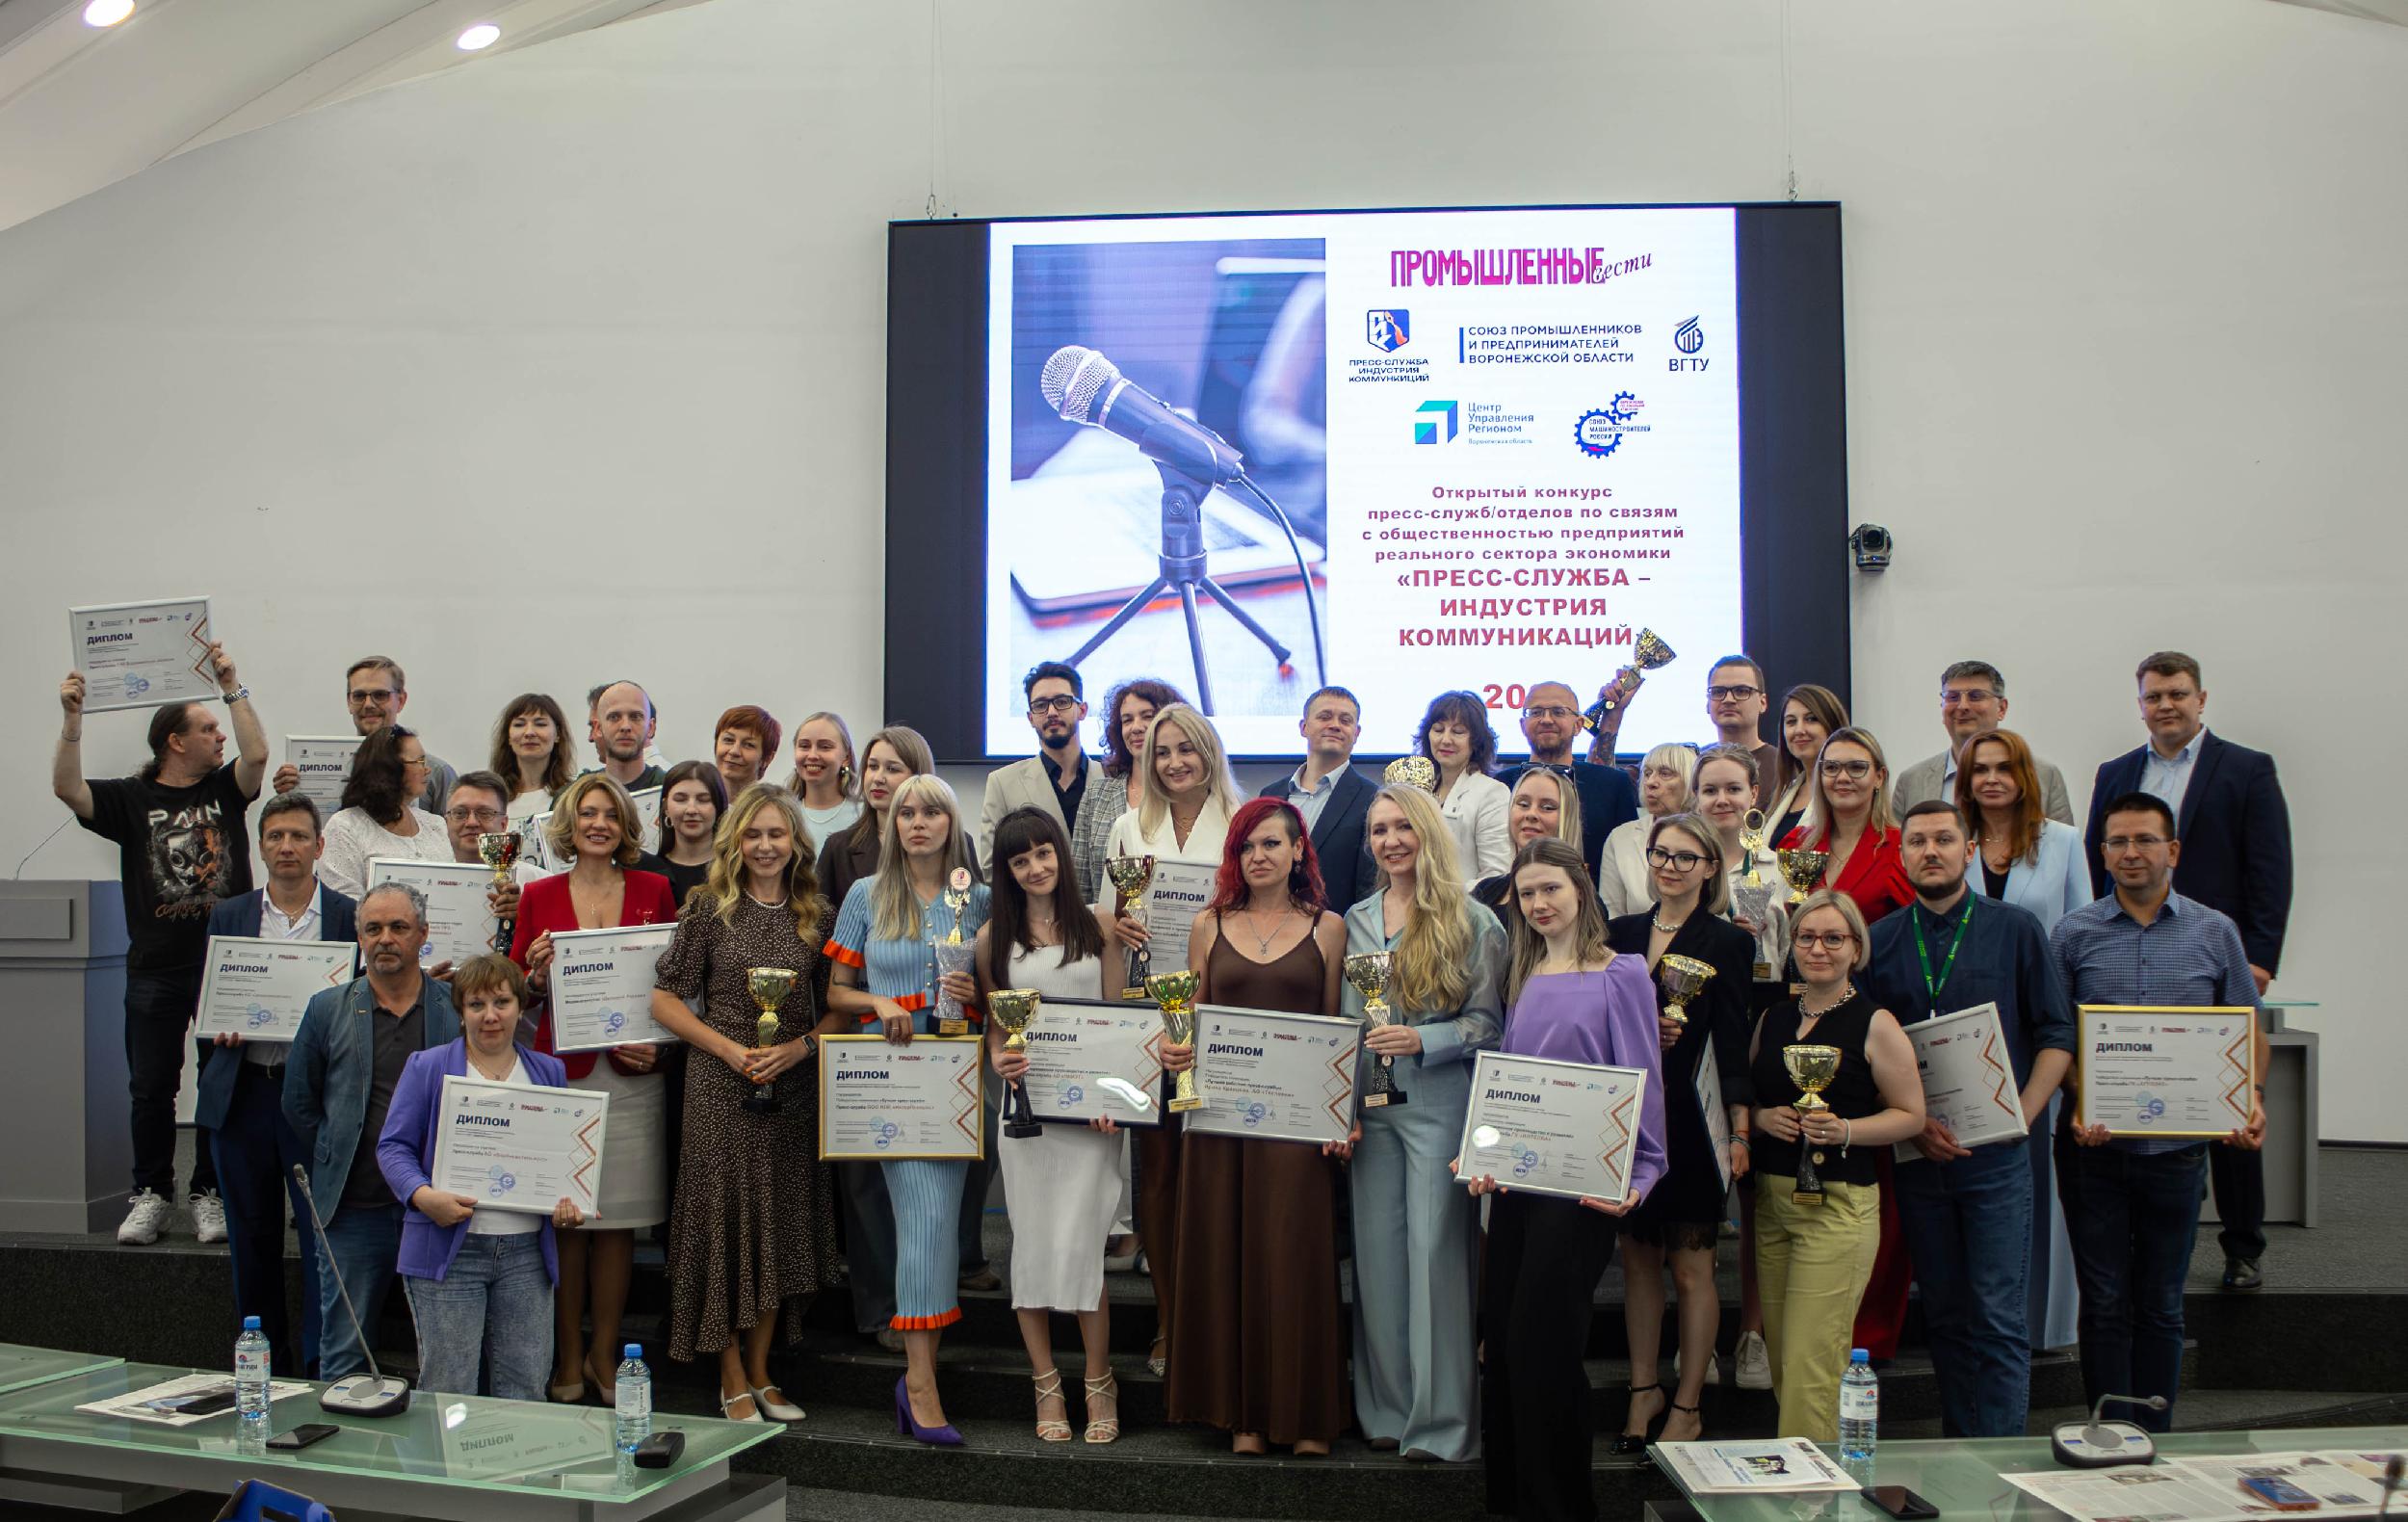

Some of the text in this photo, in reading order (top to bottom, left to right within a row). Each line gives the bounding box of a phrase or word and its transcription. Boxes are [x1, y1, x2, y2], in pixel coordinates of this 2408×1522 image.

[1391, 248, 1606, 287] ПРОМЫШЛЕННЫЕ
[1468, 324, 1642, 336] СОЮЗ ПРОМЫШЛЕННИКОВ
[1468, 337, 1619, 351] И ПРЕДПРИНИМАТЕЛЕЙ
[1469, 352, 1634, 364] ВОРОНЕЖСКОЙ ОБЛАСТИ
[1668, 357, 1710, 372] ВГТУ
[1468, 403, 1502, 413] Центр
[1468, 412, 1534, 424] Управления
[1468, 423, 1522, 433] Регионом
[1431, 485, 1612, 501] Открытый конкурс
[1368, 506, 1678, 523] пресс-служб/отделов по связям
[1362, 525, 1684, 542] с общественностью предприятий
[1374, 549, 1670, 564] реального сектора экономики
[1397, 567, 1630, 588] «ПРЕСС-СЛУЖБА
[1440, 598, 1607, 619] ИНДУСТРИЯ
[87, 632, 133, 645] ДИПЛОМ
[1399, 623, 1632, 649] КОММУНИКАЦИЙ
[1482, 683, 1526, 710] 20
[299, 764, 343, 774] ДИПЛОМ
[148, 799, 222, 829] PAIN
[1153, 889, 1206, 903] ДИПЛОМ
[220, 963, 269, 974] ДИПЛОМ
[563, 961, 615, 977] ДИПЛОМ
[1026, 1031, 1078, 1043] ДИПЛОМ
[1207, 1043, 1264, 1058] ДИПЛОМ
[2095, 1042, 2153, 1053] ДИПЛОМ
[837, 1070, 890, 1081] ДИПЛОМ
[1485, 1089, 1541, 1104] ДИПЛОМ
[456, 1114, 510, 1128] ДИПЛОМ
